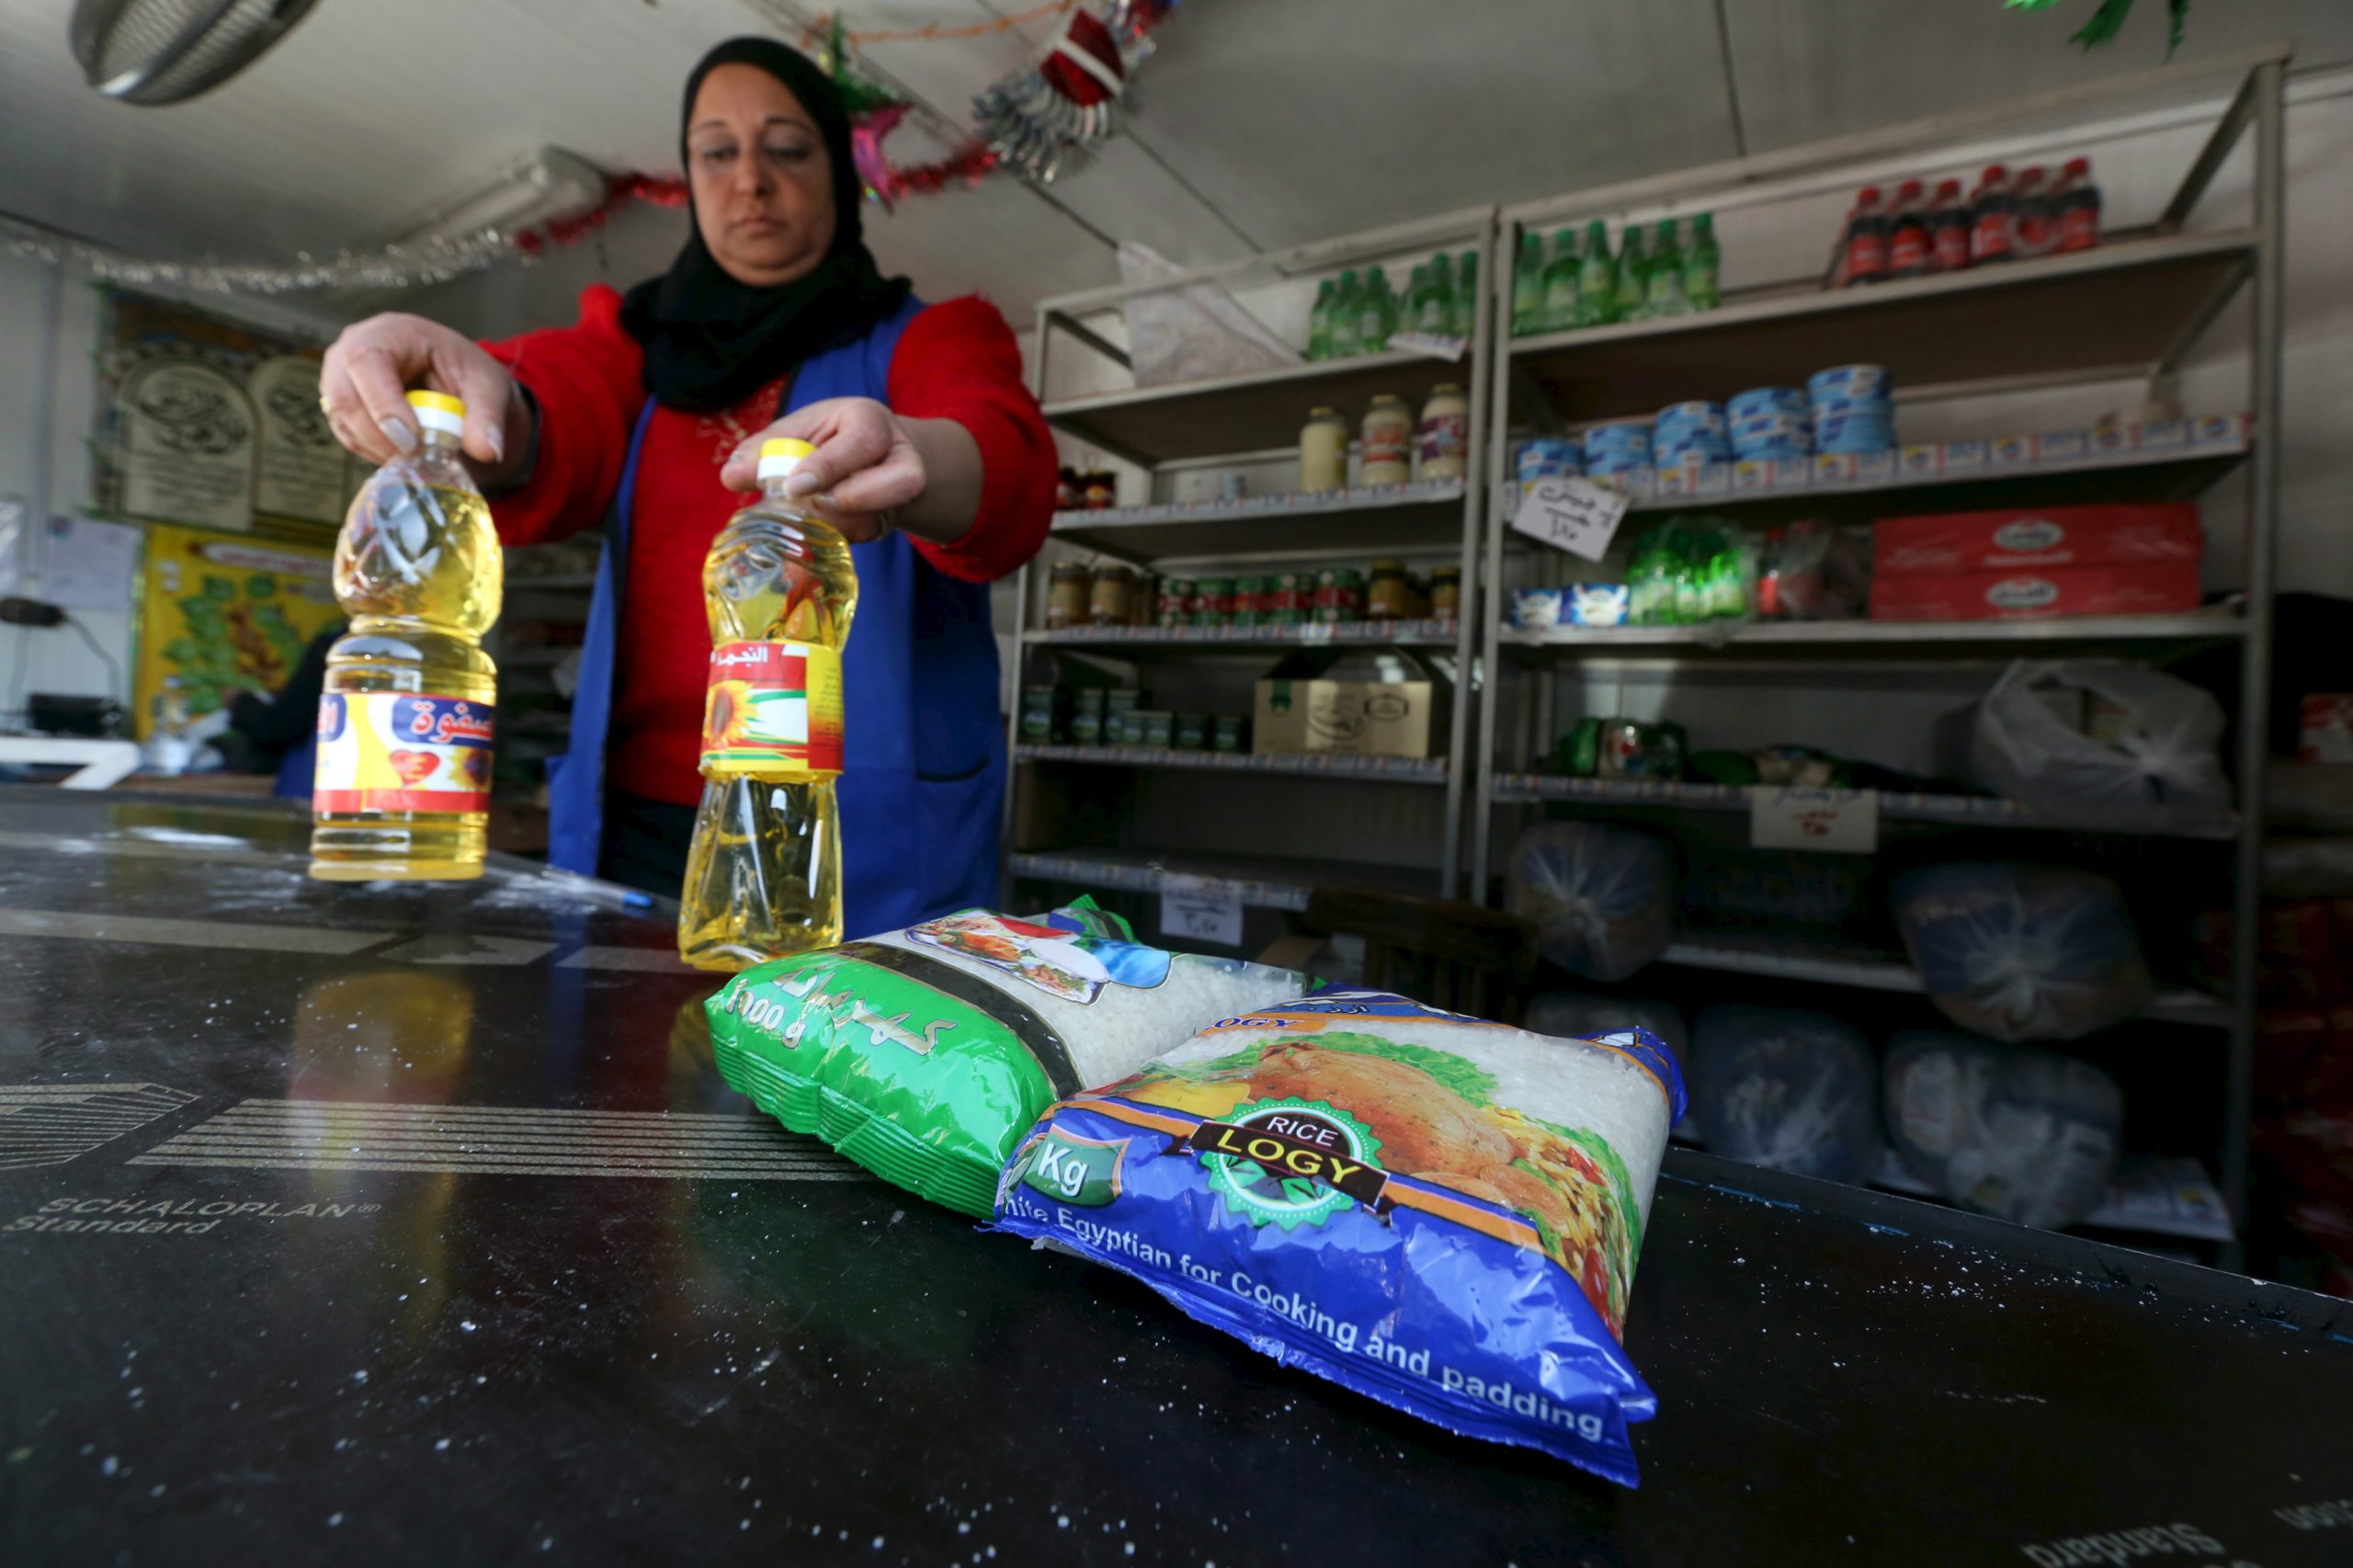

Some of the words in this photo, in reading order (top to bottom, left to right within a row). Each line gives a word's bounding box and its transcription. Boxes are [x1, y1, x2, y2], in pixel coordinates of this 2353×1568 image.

[724, 978, 787, 1031] 1000
[1204, 1017, 1305, 1031] OGY
[1216, 1128, 1362, 1185] LOGY
[1267, 1115, 1339, 1148] RICE
[1037, 1142, 1089, 1197] Kg
[3, 1214, 222, 1235] Standard
[1058, 1207, 1172, 1270] Egyptian
[1179, 1254, 1222, 1284] for
[1231, 1270, 1358, 1352] Cooking
[1369, 1333, 1431, 1377] and
[1441, 1364, 1604, 1442] padding
